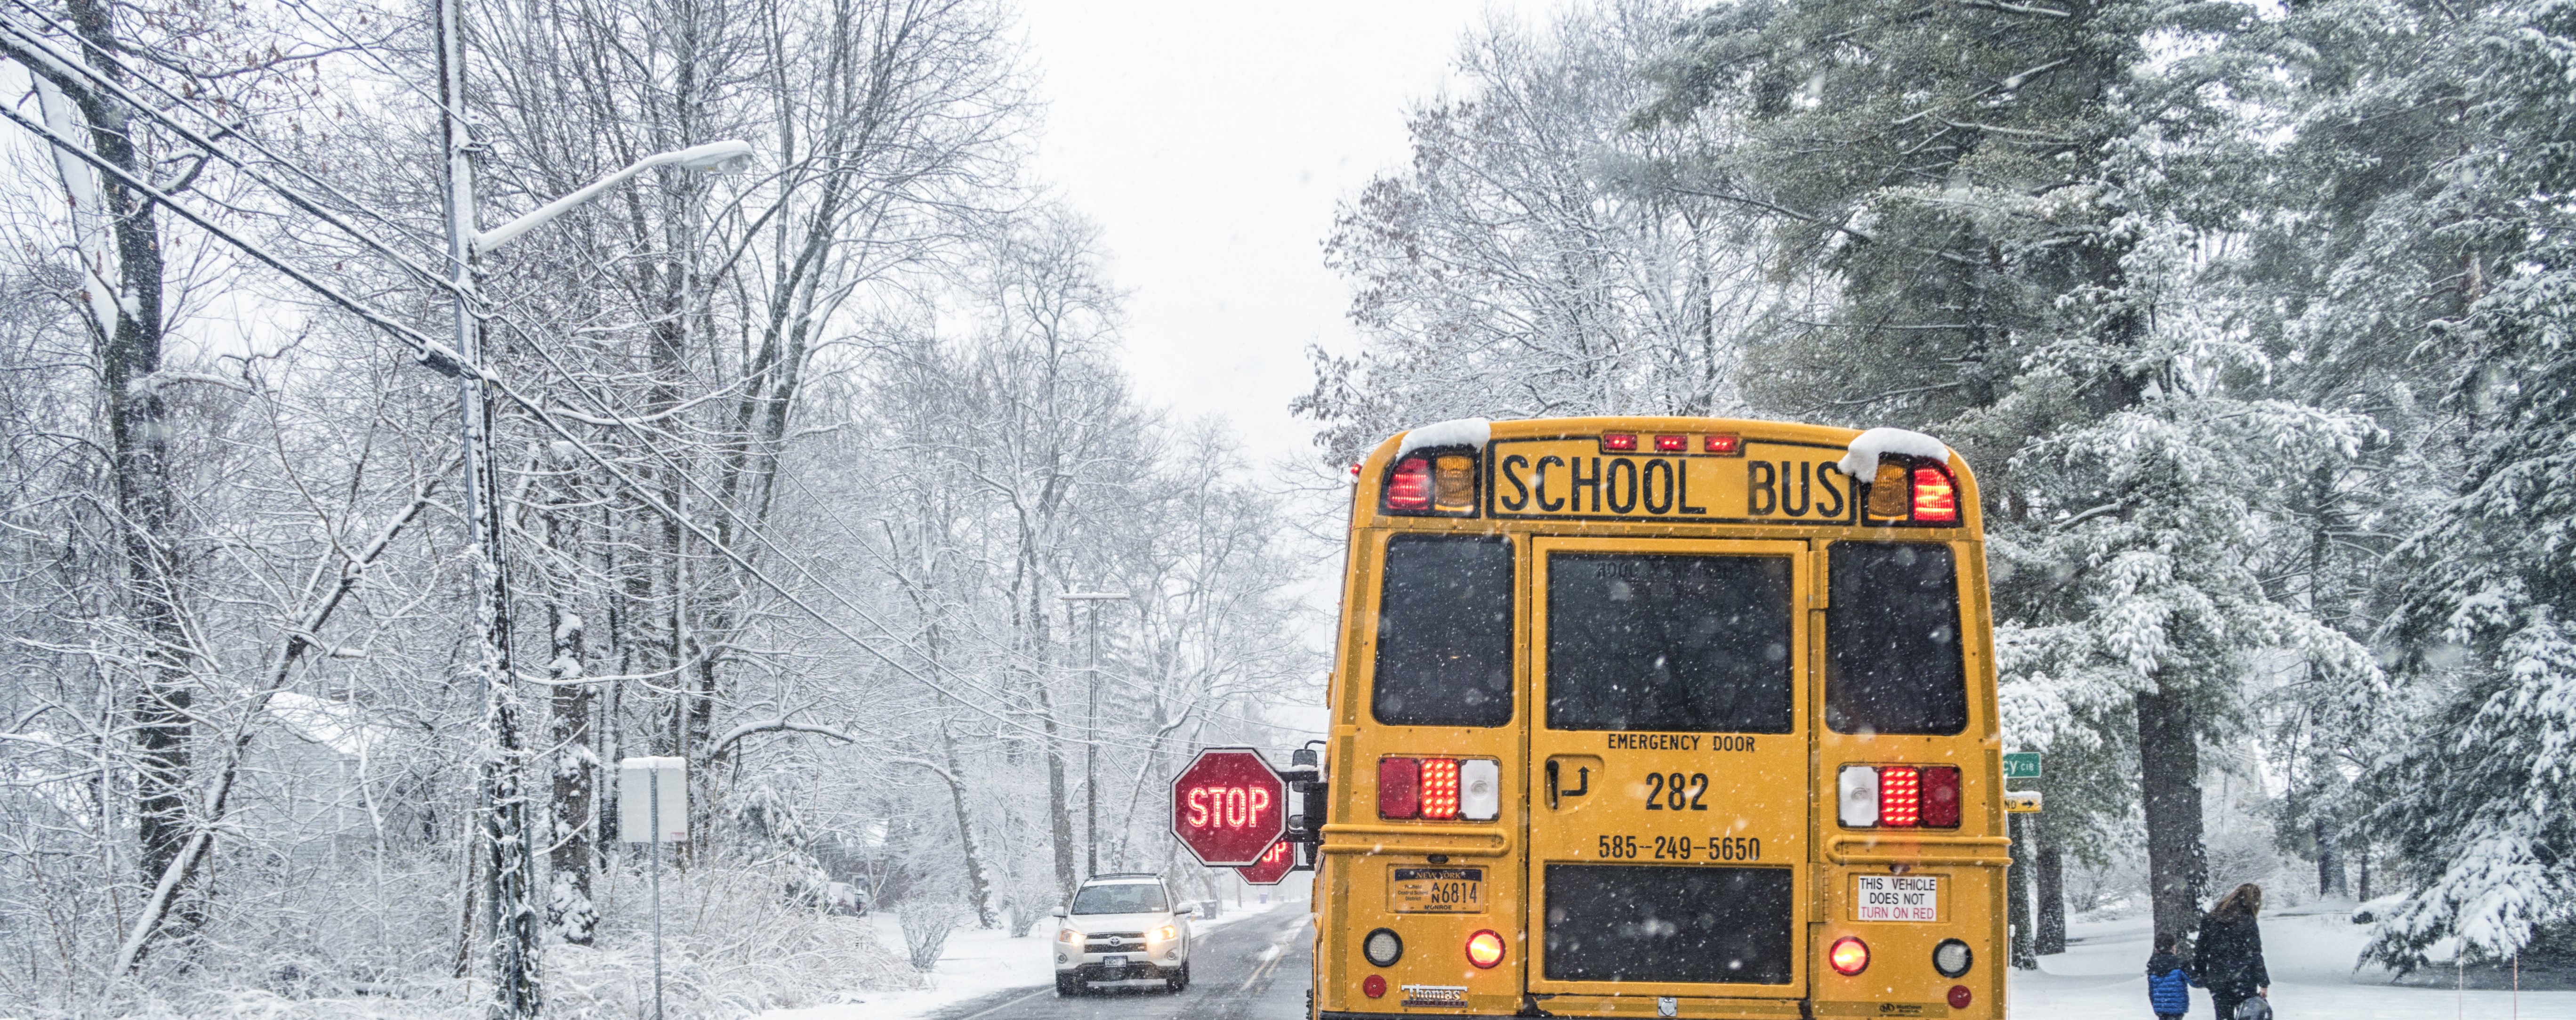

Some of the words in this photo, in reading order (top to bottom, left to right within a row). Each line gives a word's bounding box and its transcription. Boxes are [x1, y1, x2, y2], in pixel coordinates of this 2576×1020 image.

[1501, 454, 1707, 515] SCHOOL
[1747, 460, 1843, 518] BUS
[1608, 734, 1700, 751] EMERGENCY
[1713, 736, 1755, 752] DOOR
[1646, 772, 1709, 811] 282
[1188, 787, 1269, 827] STOP
[1442, 882, 1477, 903] 6814
[1860, 878, 1883, 890] THIS
[1892, 878, 1935, 890] VEHICLE
[1870, 892, 1899, 904] DOES
[1904, 893, 1924, 905] NOT
[1861, 907, 1888, 918] TURN
[1893, 907, 1908, 918] ON
[1913, 908, 1934, 919] RED
[1401, 984, 1467, 1000] Thomas
